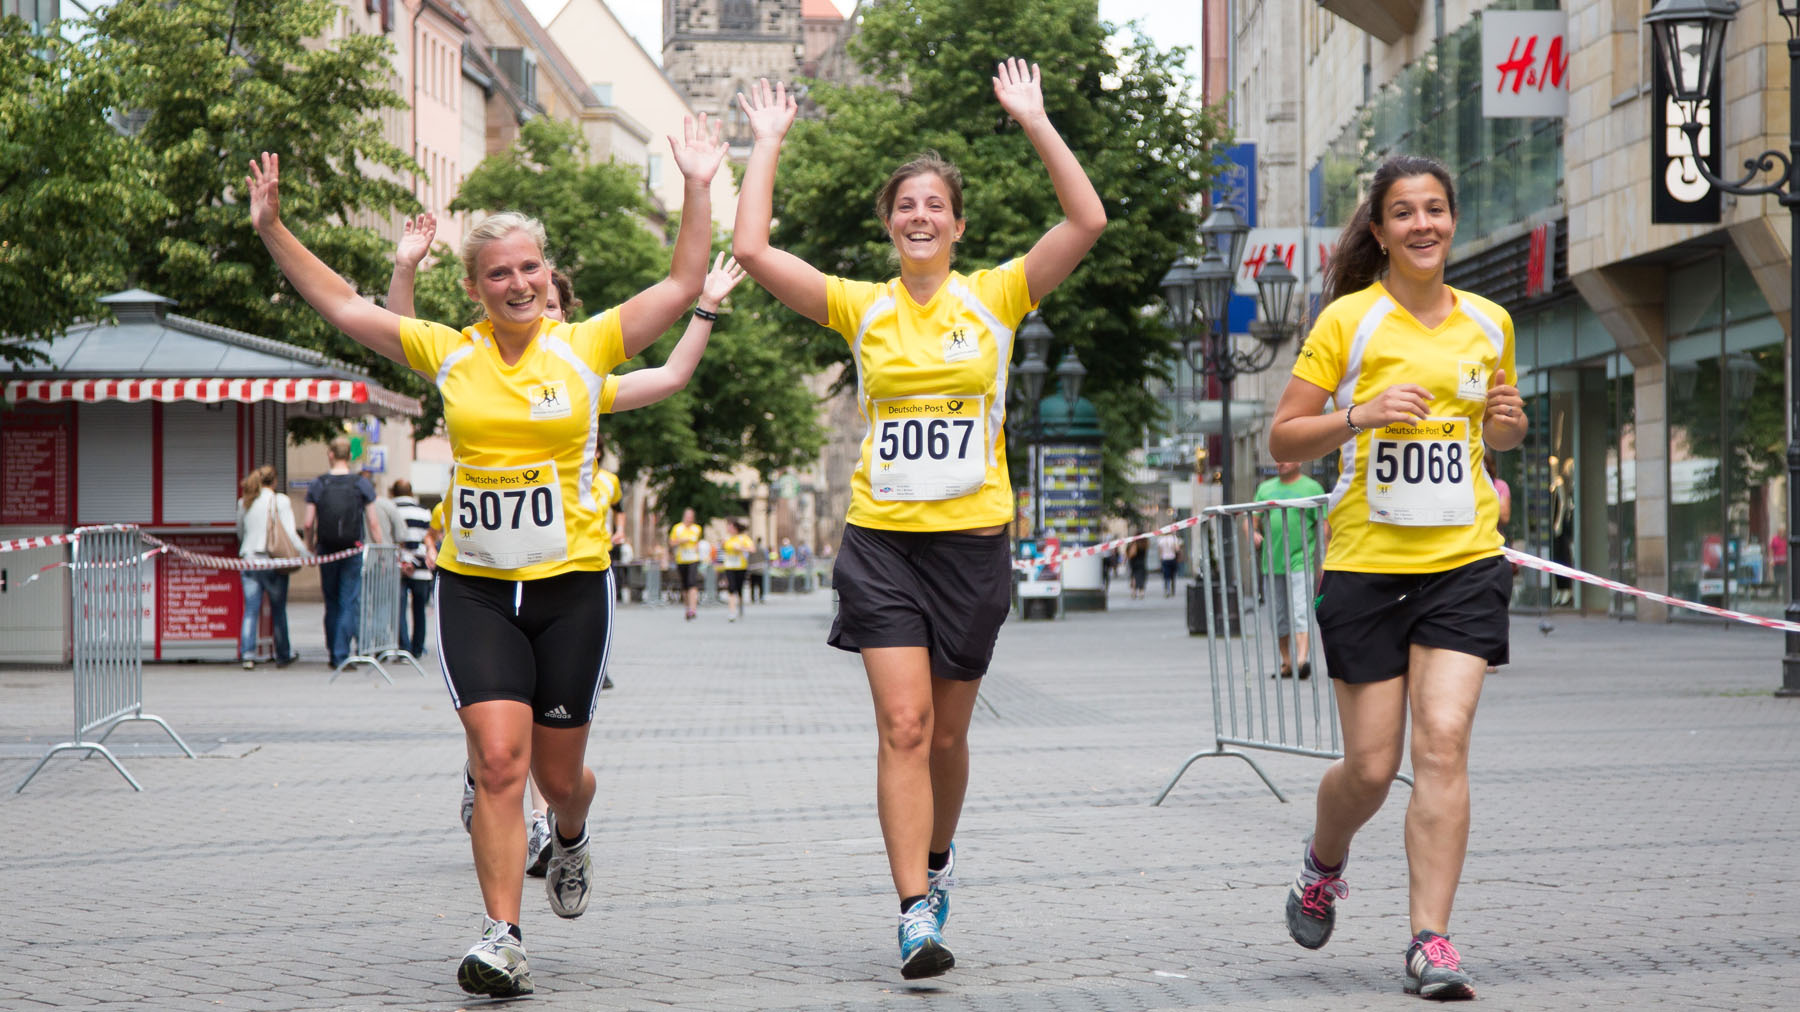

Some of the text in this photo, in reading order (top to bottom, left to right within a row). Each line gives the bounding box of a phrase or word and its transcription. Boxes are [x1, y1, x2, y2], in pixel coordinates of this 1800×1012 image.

[1496, 34, 1569, 95] H&M
[888, 404, 944, 414] Deutsche Post
[1384, 424, 1440, 436] Deutsche Post
[879, 419, 975, 461] 5067
[465, 473, 519, 485] Deutsche Post
[1375, 441, 1464, 485] 5068
[459, 487, 554, 531] 5070
